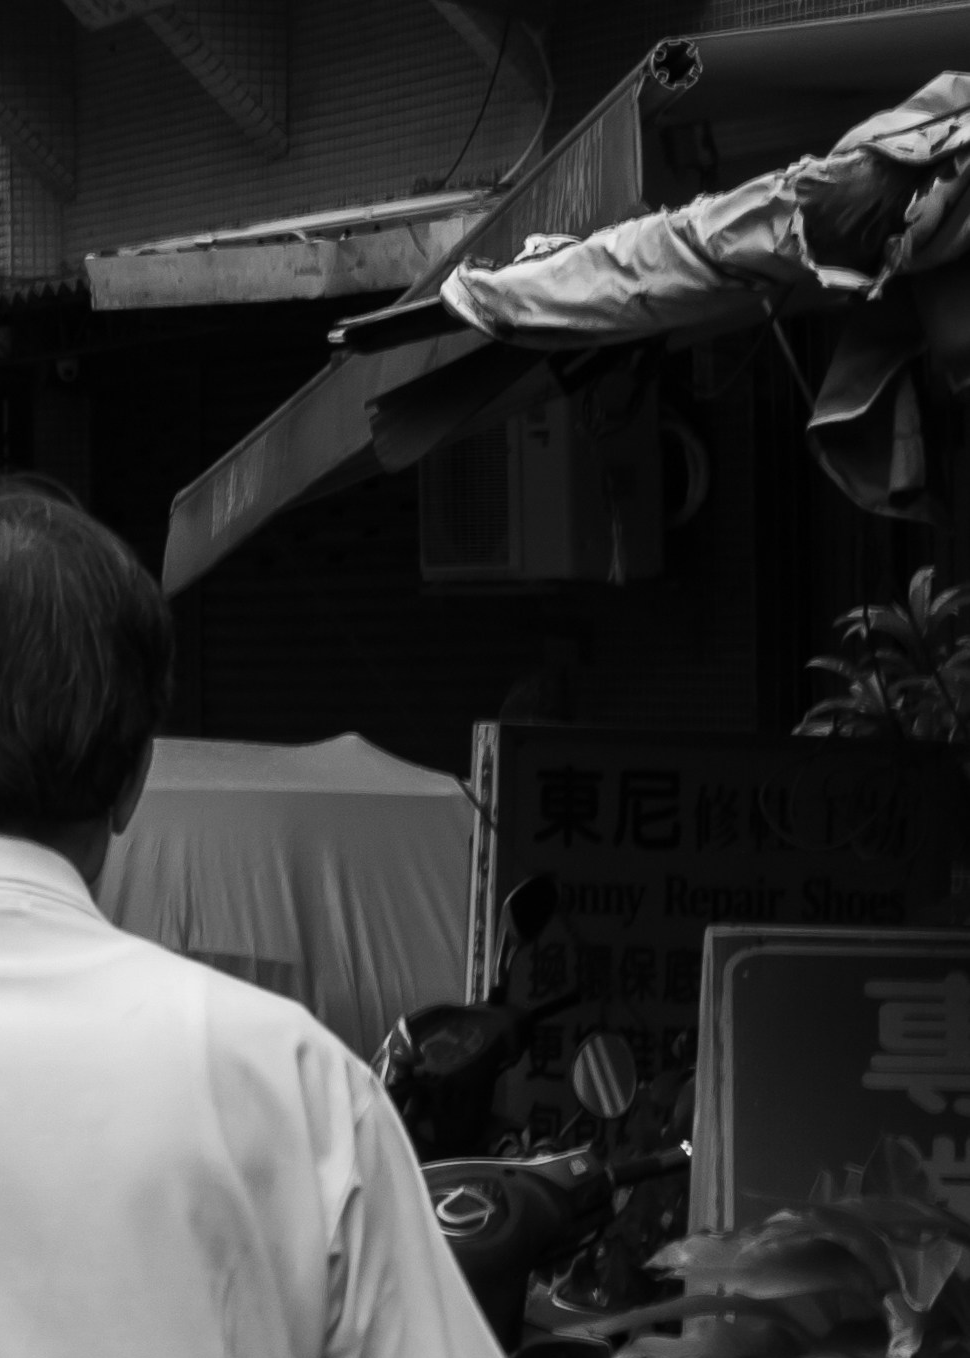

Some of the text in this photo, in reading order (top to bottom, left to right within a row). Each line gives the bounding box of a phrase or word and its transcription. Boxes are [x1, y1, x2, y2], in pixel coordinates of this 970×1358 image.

[554, 872, 907, 930] onny Repair Shoes
